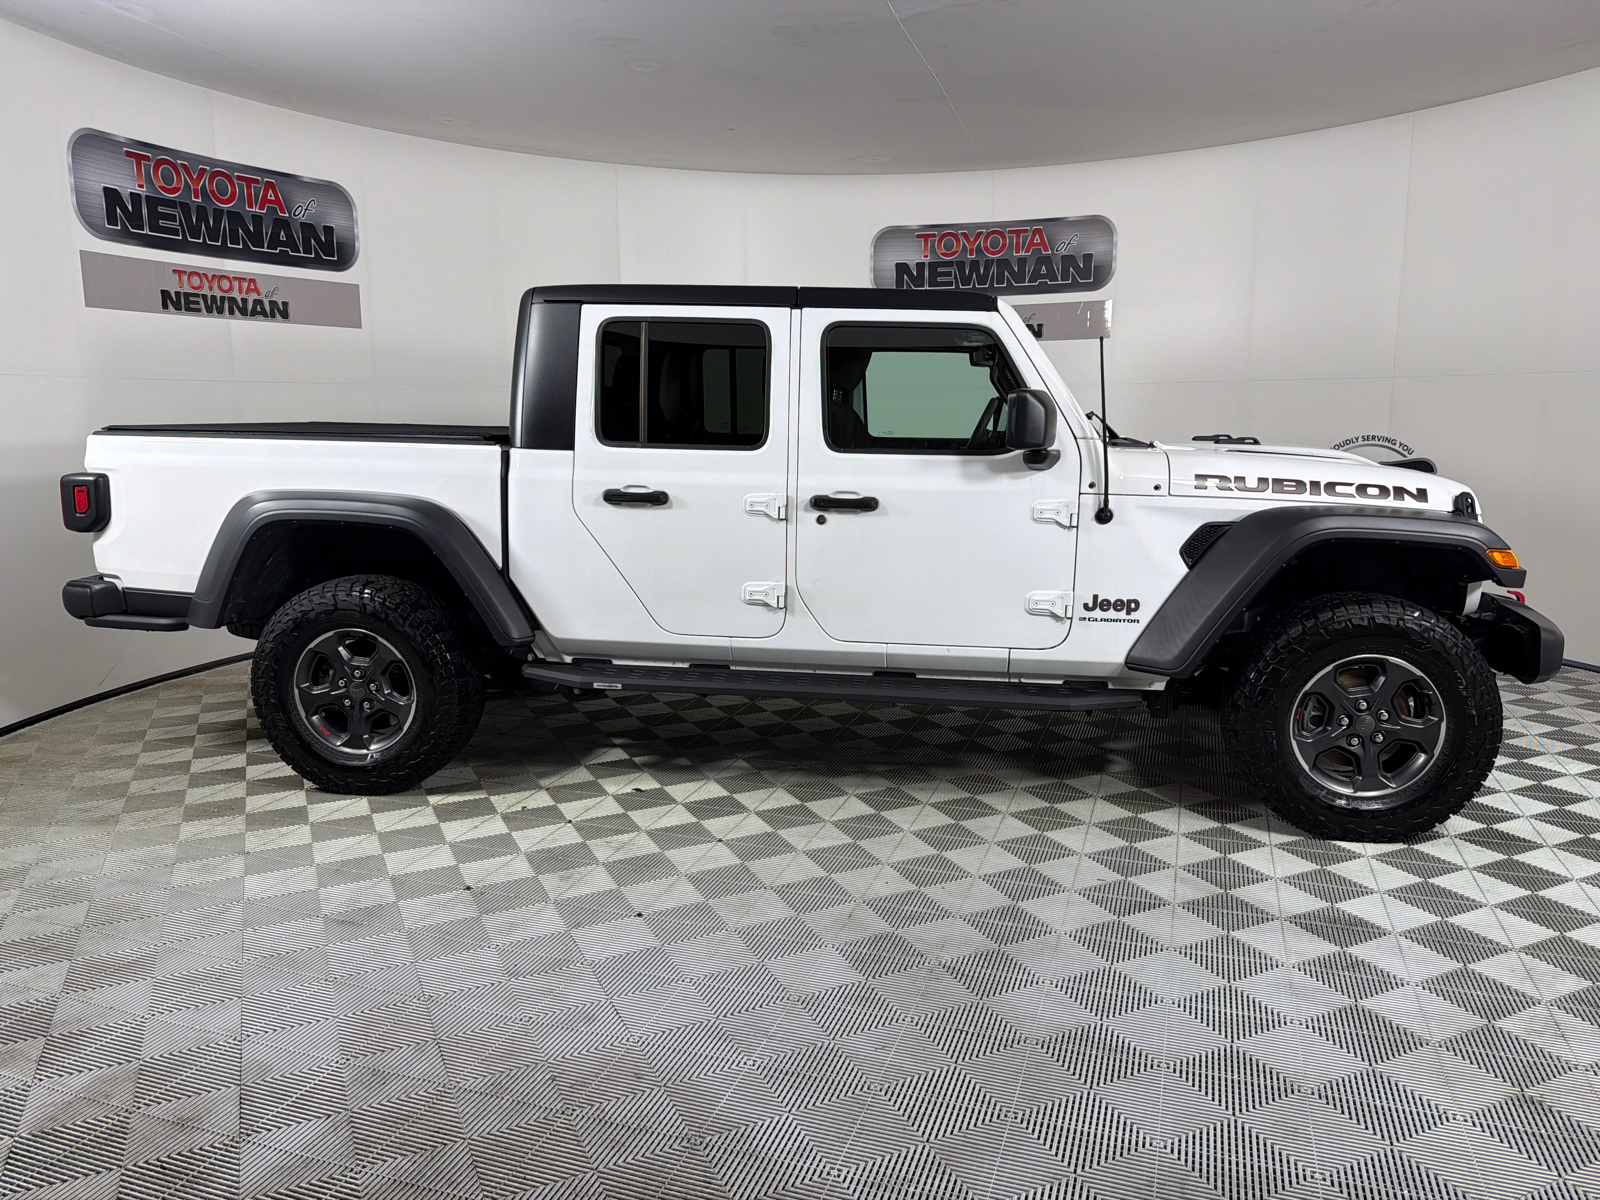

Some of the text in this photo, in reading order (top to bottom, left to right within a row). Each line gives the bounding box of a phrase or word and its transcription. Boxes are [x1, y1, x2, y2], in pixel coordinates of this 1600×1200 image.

[123, 148, 316, 219] TOYOTA of
[102, 185, 338, 260] NEWNAN
[915, 226, 1080, 259] TOYOTA of
[172, 269, 280, 300] TOYOTA of
[894, 252, 1094, 289] NEWNAN
[160, 288, 291, 320] NEWNAN
[1330, 434, 1415, 456] OUDLY SERVING YOU
[1194, 473, 1429, 503] RUBICON
[1083, 594, 1140, 616] Jeep
[1087, 616, 1140, 624] GLADIATOR
